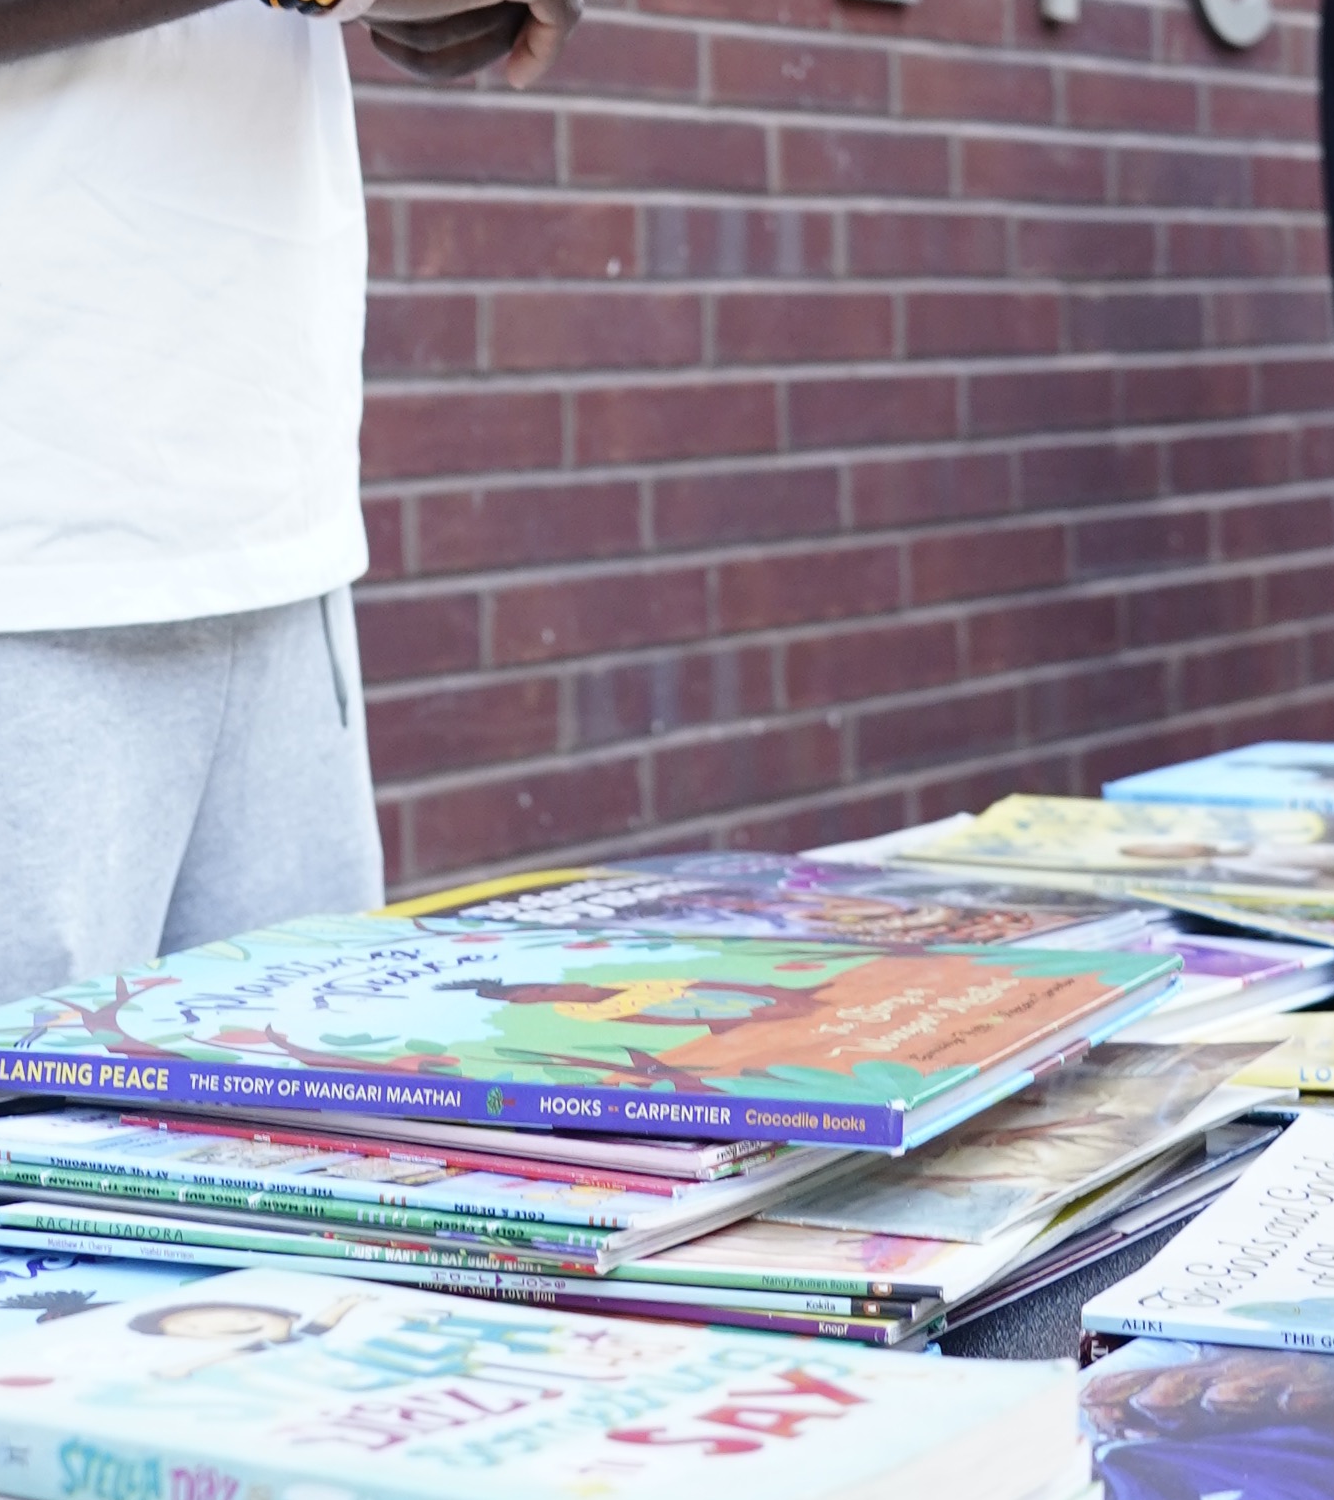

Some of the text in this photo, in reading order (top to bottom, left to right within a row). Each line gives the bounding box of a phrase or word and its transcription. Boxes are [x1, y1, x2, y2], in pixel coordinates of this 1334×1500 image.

[98, 1060, 169, 1091] PEACE
[190, 1073, 220, 1093] THE
[223, 1075, 274, 1097] STORY
[277, 1079, 300, 1098] OF
[304, 1080, 382, 1103] WANGARI
[386, 1085, 462, 1108] MAATHAI
[540, 1097, 602, 1116] HOOKS
[624, 1101, 731, 1125] CARPENTIER
[745, 1108, 819, 1130] Crocodile
[822, 1111, 866, 1133] Books
[50, 1156, 129, 1175] WATERWORKS
[49, 1177, 94, 1191] HUMAN
[193, 1174, 216, 1187] BUS
[218, 1177, 265, 1192] SCHOOL
[269, 1183, 308, 1195] MAGIC
[311, 1187, 334, 1197] THE
[208, 1193, 258, 1210] CHOOL
[454, 1203, 496, 1217] DEGEN
[511, 1211, 545, 1222] COLE
[36, 1215, 184, 1242] RACHEL ISADORA
[48, 1239, 77, 1250] Matthew
[87, 1242, 113, 1255] Cherry
[164, 1248, 195, 1260] Harrison
[351, 1247, 382, 1260] JUST
[385, 1249, 421, 1263] WANT
[424, 1250, 439, 1264] TO
[441, 1252, 463, 1266] SAY
[762, 1275, 791, 1288] Nancy
[830, 1280, 859, 1291] Books
[502, 1288, 530, 1301] Love
[806, 1300, 836, 1313] Kokila
[819, 1322, 849, 1338] Knopf
[1121, 1318, 1164, 1334] ALIKI
[1281, 1331, 1316, 1348] THE
[605, 1367, 874, 1457] SAY
